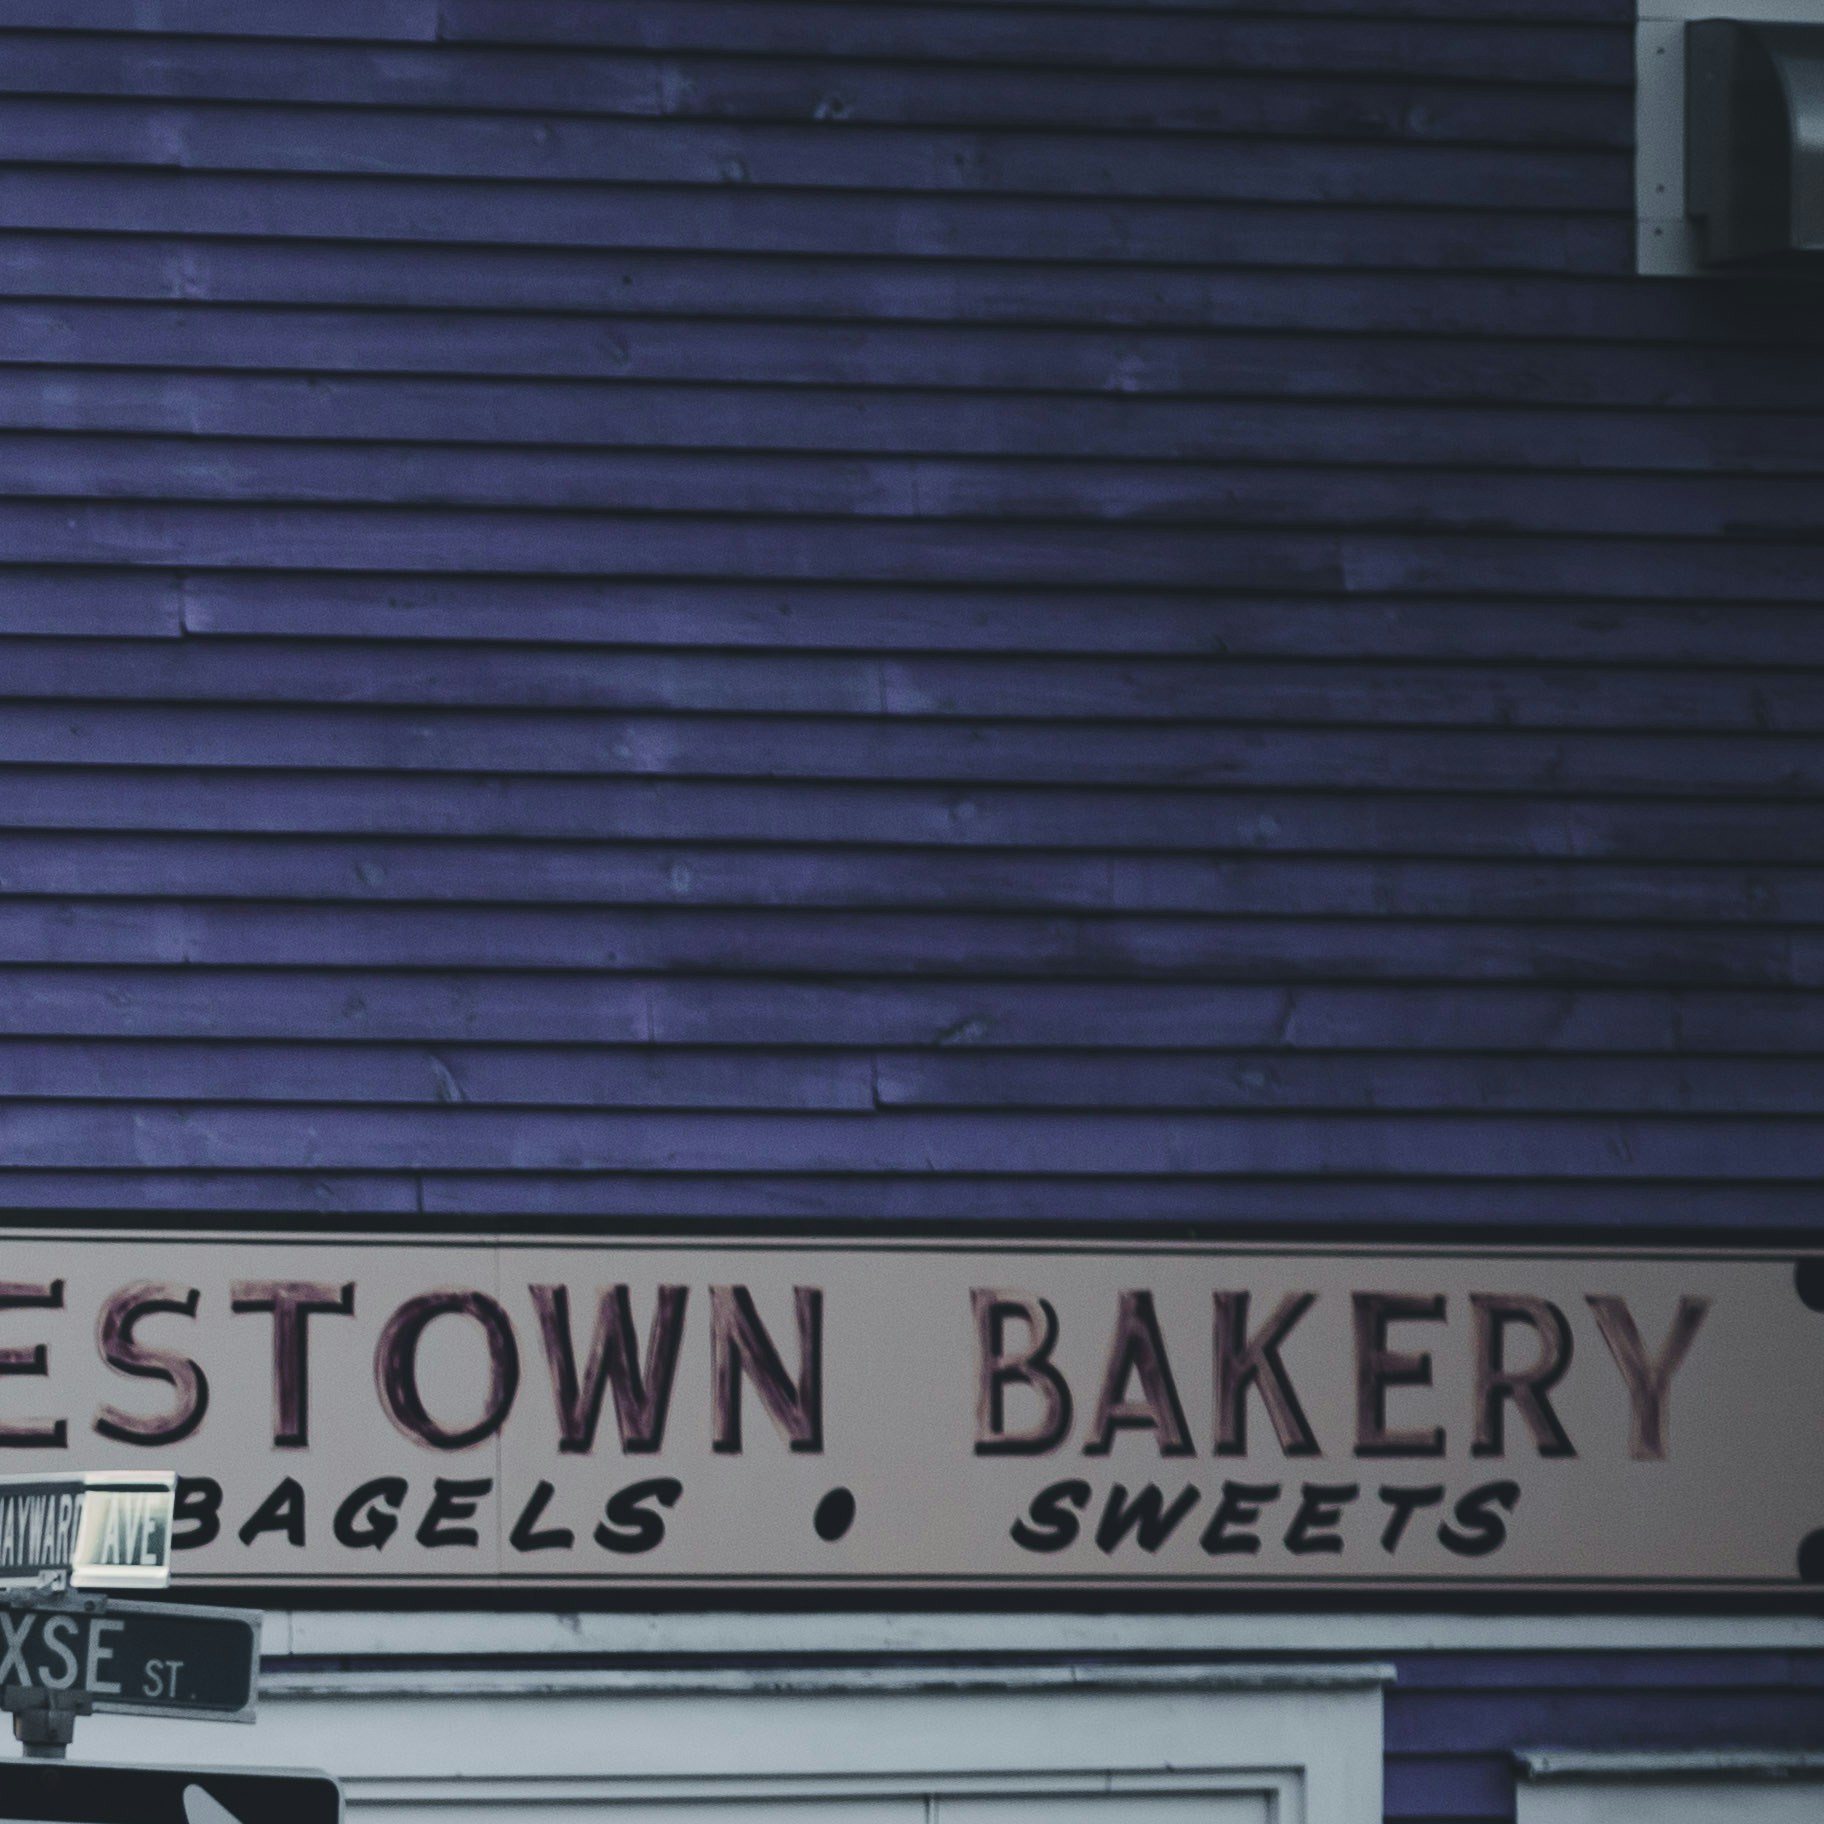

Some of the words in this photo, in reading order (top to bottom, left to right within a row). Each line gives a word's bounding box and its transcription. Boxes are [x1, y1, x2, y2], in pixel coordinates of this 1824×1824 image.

[966, 1285, 1713, 1462] BAKERY
[100, 1493, 158, 1567] AVE
[172, 1476, 685, 1554] BAGELS
[1009, 1478, 1524, 1557] SWEETS
